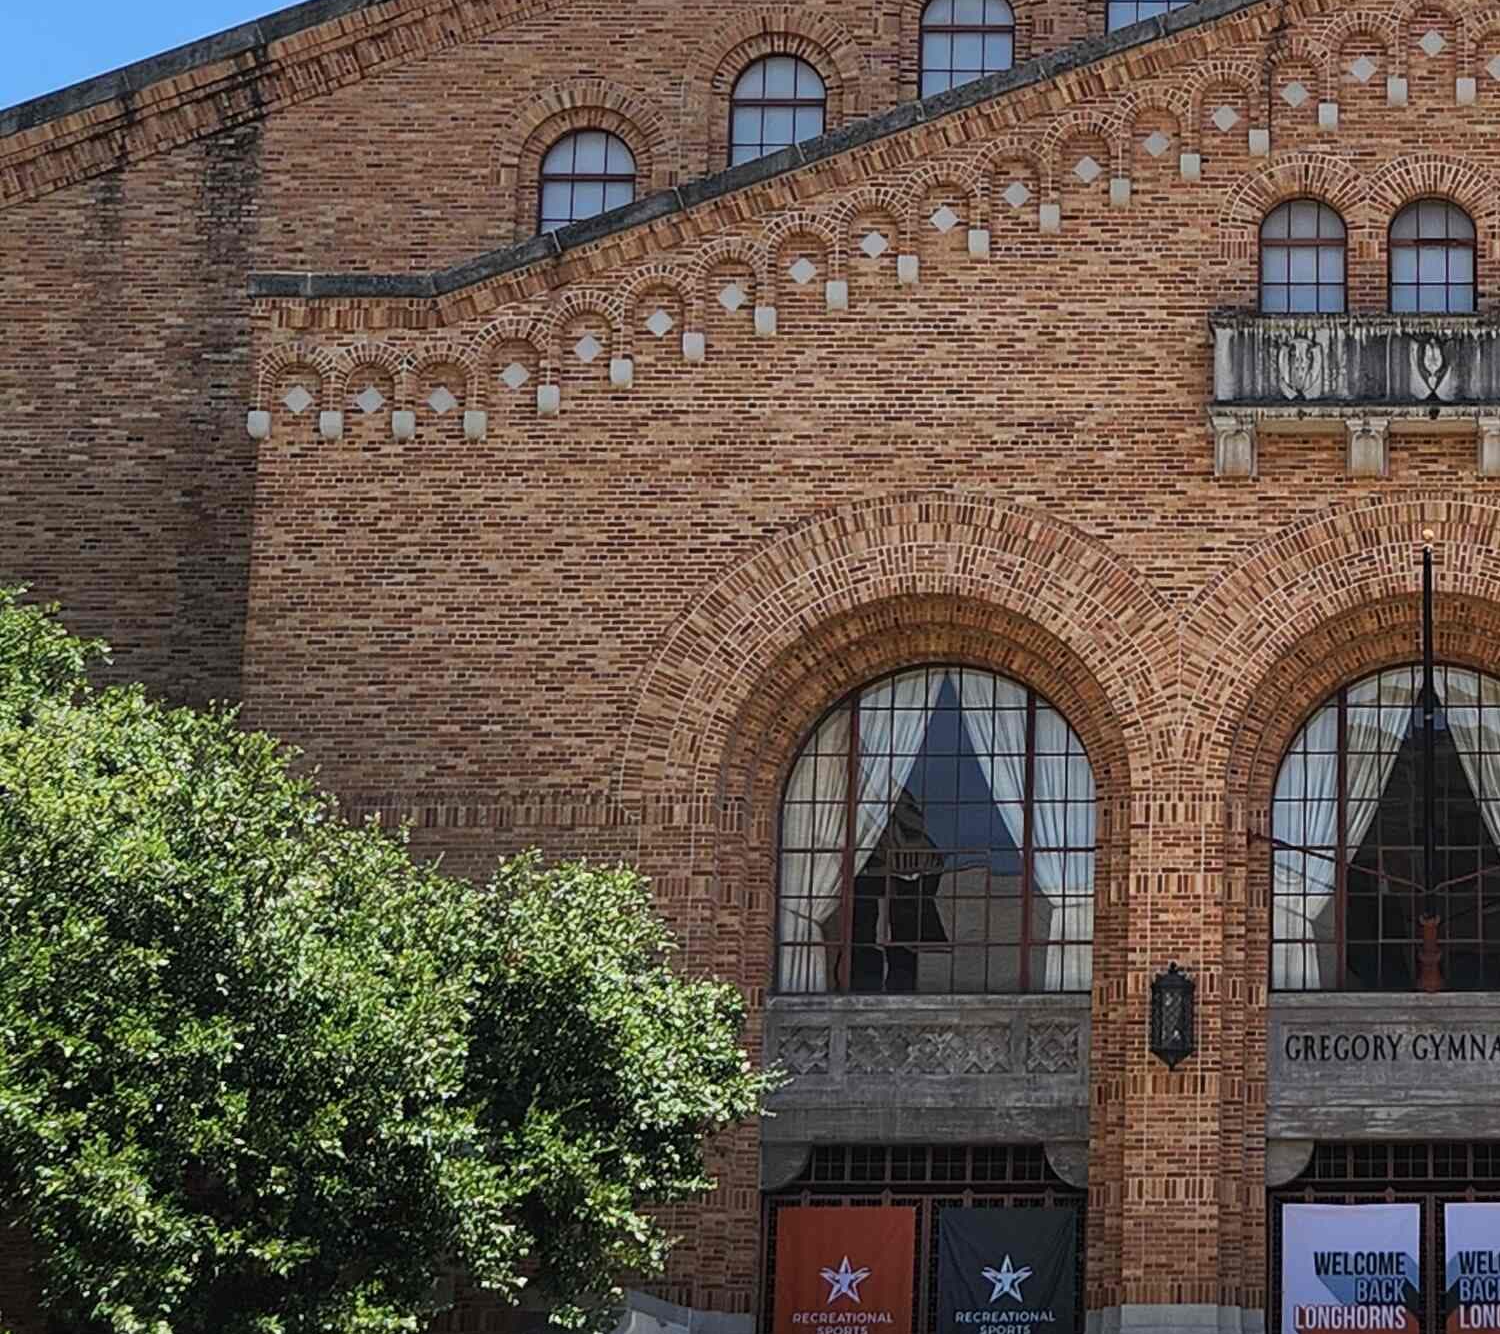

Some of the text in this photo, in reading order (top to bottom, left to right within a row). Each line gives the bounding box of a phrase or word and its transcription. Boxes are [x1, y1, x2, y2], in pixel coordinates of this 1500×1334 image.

[1285, 1034, 1403, 1061] GREGORY
[1314, 1251, 1406, 1276] WELCOME
[1357, 1277, 1406, 1303] BACK
[792, 1312, 893, 1324] RECREATIONAL
[955, 1310, 1055, 1323] RECREATIONAL
[1295, 1305, 1406, 1329] LONGHORNS
